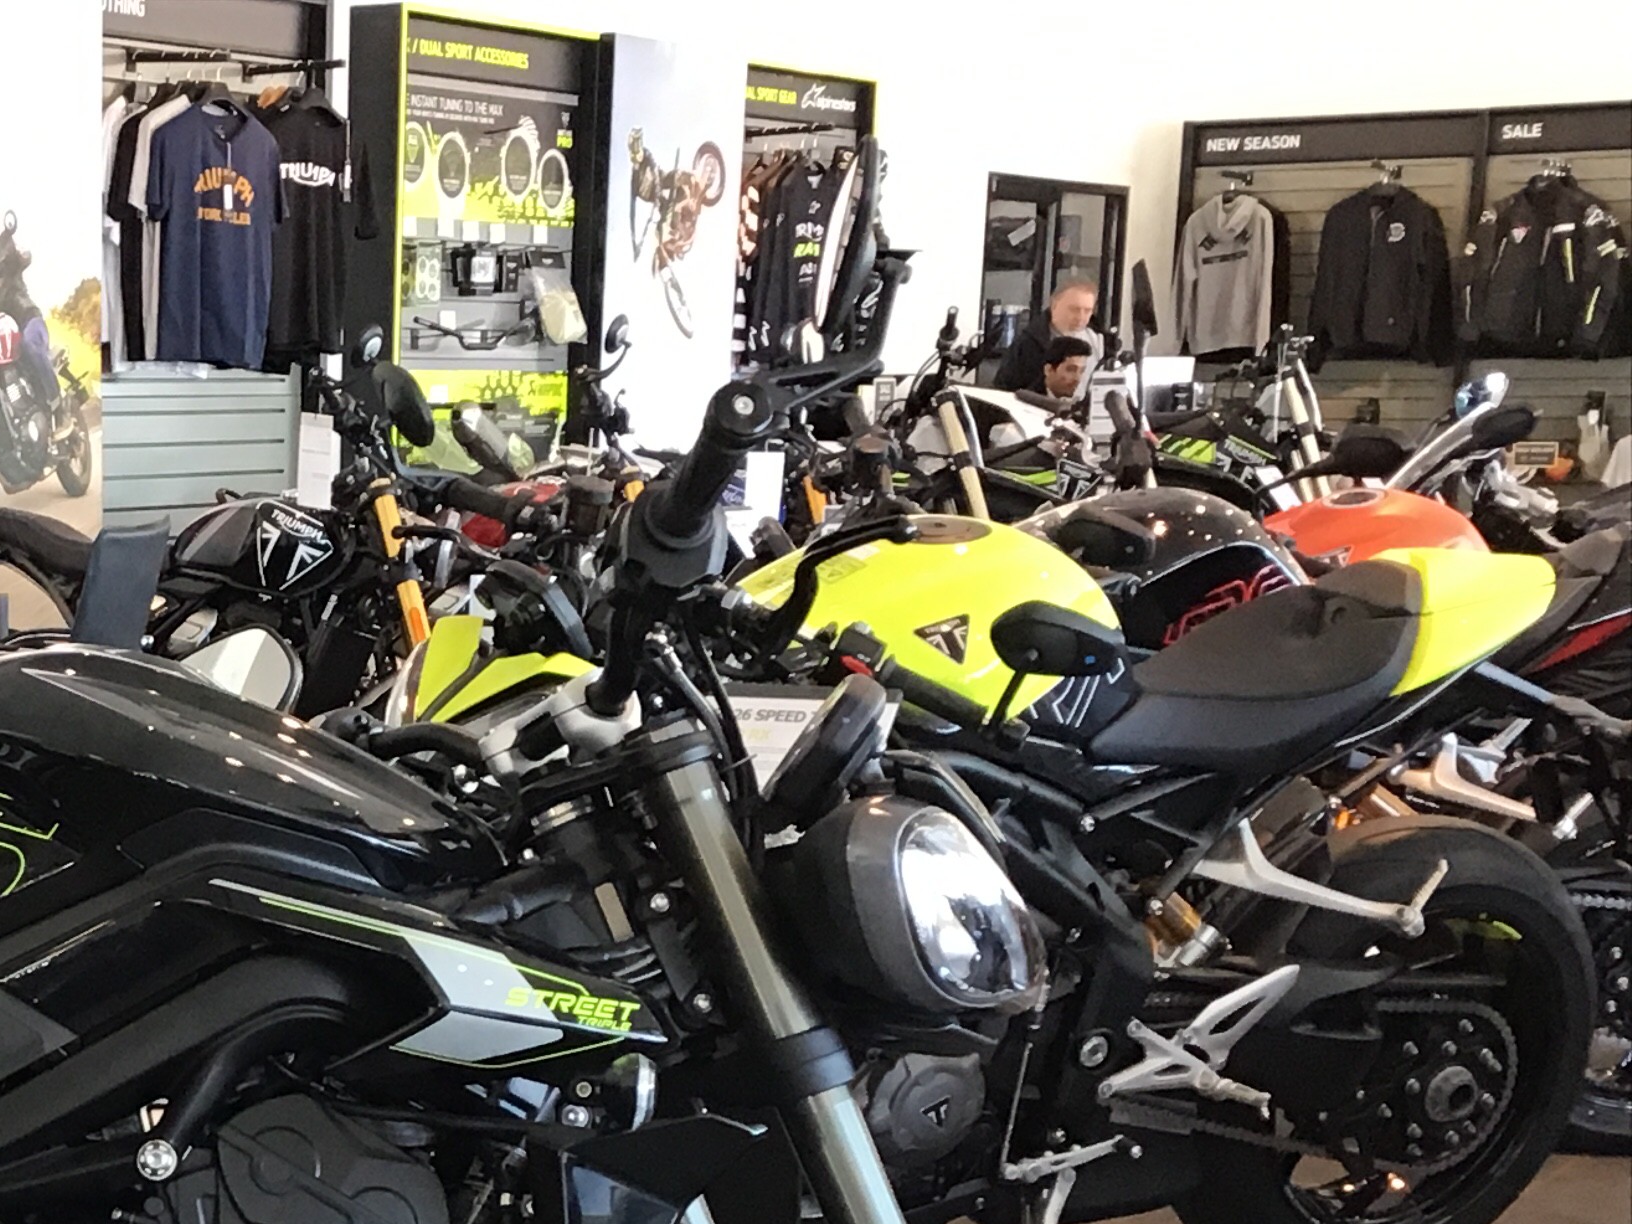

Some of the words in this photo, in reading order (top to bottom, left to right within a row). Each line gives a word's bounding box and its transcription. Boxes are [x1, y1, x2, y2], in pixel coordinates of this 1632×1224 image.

[420, 38, 443, 56] DUAL
[445, 42, 473, 60] SPORT
[474, 46, 530, 69] ACCESSORIES
[463, 99, 474, 114] TO
[474, 100, 488, 116] THE
[1502, 122, 1544, 139] SALE
[1206, 136, 1241, 152] NEW
[1244, 134, 1301, 151] SEASON
[279, 162, 336, 187] TRIUMPH
[271, 508, 326, 542] TRIUMPH
[754, 708, 807, 723] SPEED
[504, 986, 641, 1021] STREET
[576, 1015, 633, 1032] TRIPLE
